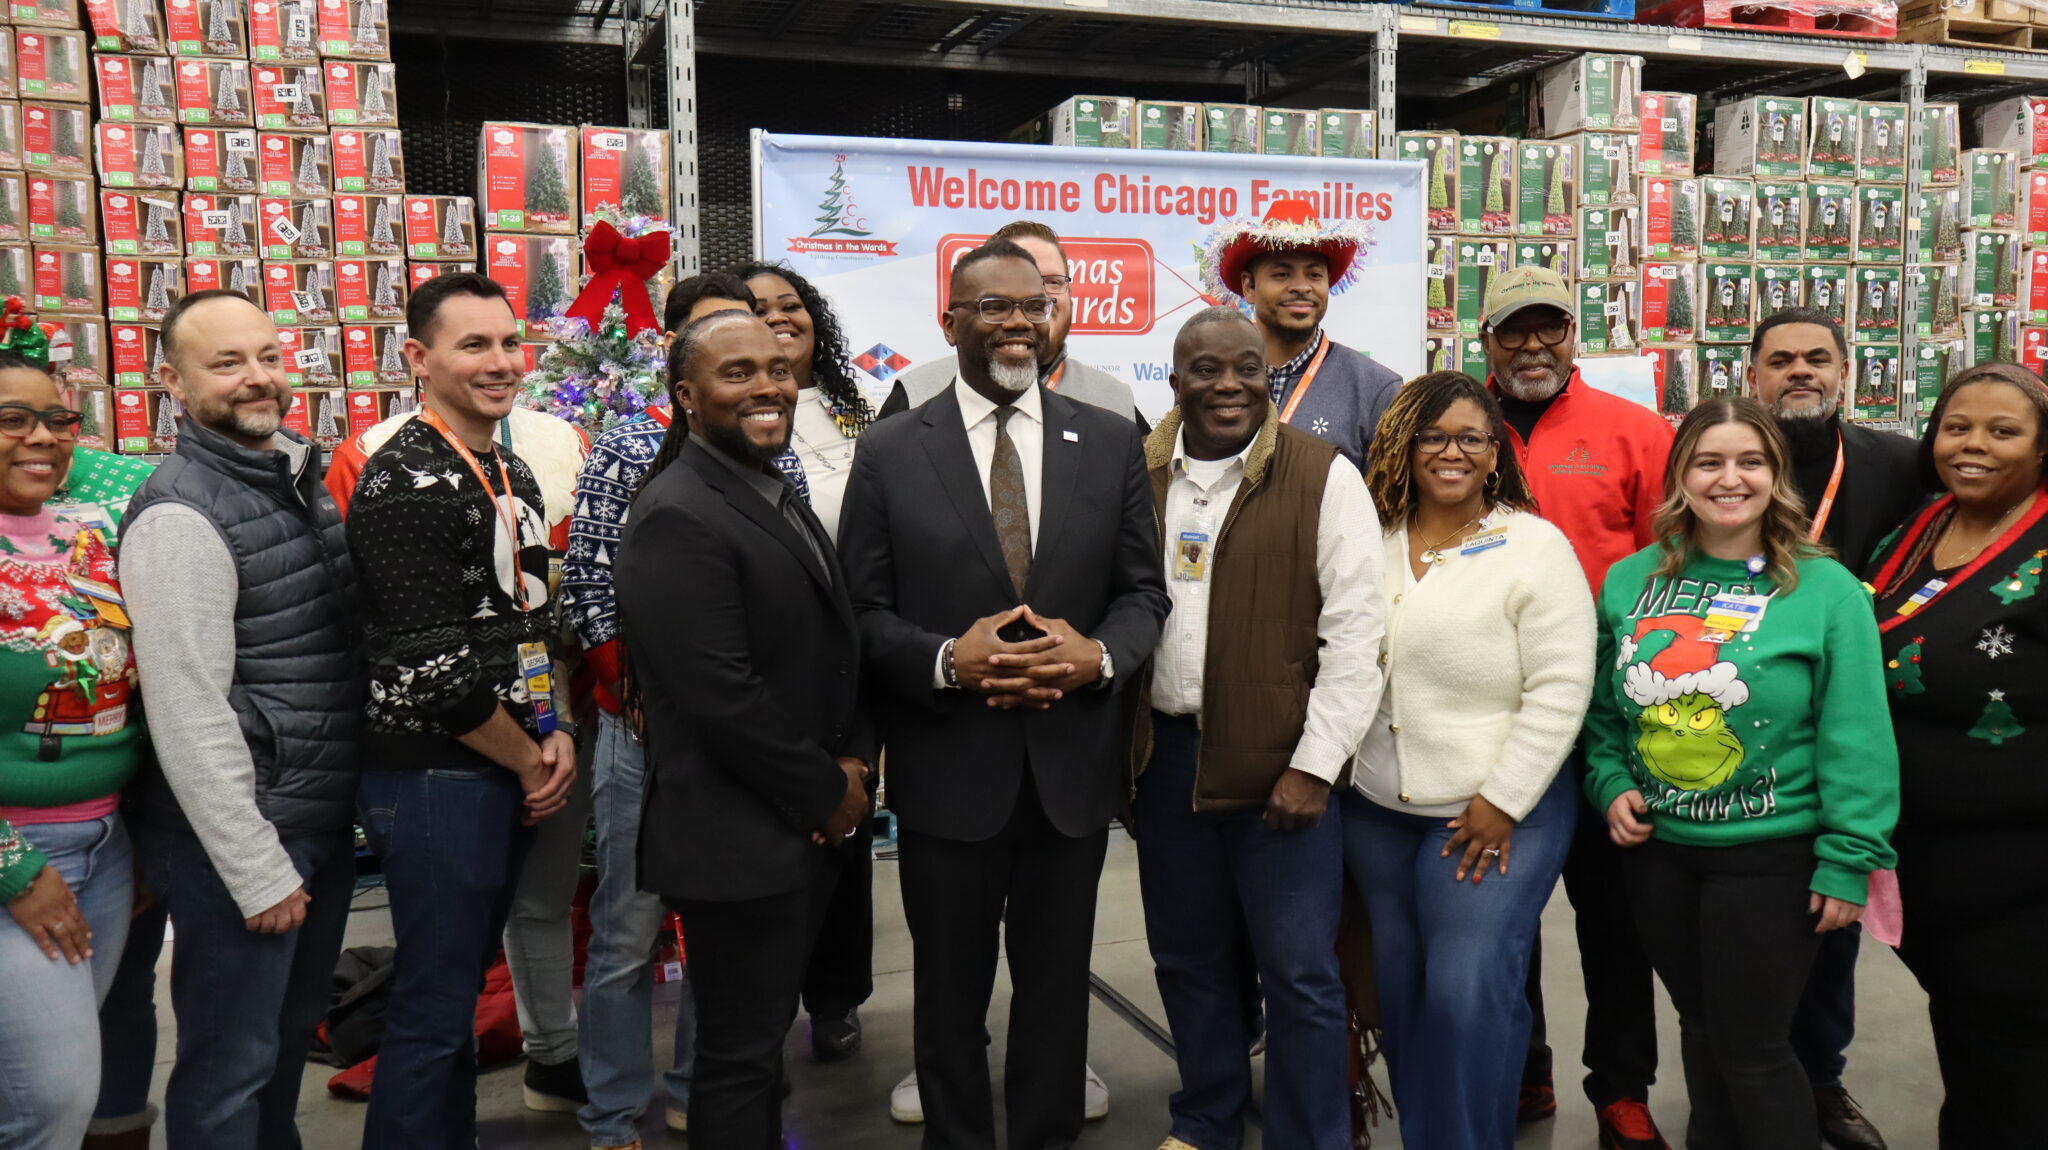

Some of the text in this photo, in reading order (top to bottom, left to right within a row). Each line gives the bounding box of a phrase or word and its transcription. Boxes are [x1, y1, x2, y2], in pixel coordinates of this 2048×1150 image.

[907, 166, 1080, 212] Welcome
[1094, 173, 1238, 225] Chicago
[796, 240, 887, 251] Christmas in the Wards
[1465, 534, 1504, 548] LAQUINTA
[1721, 603, 1748, 611] KATIE
[527, 655, 547, 667] GEORGE
